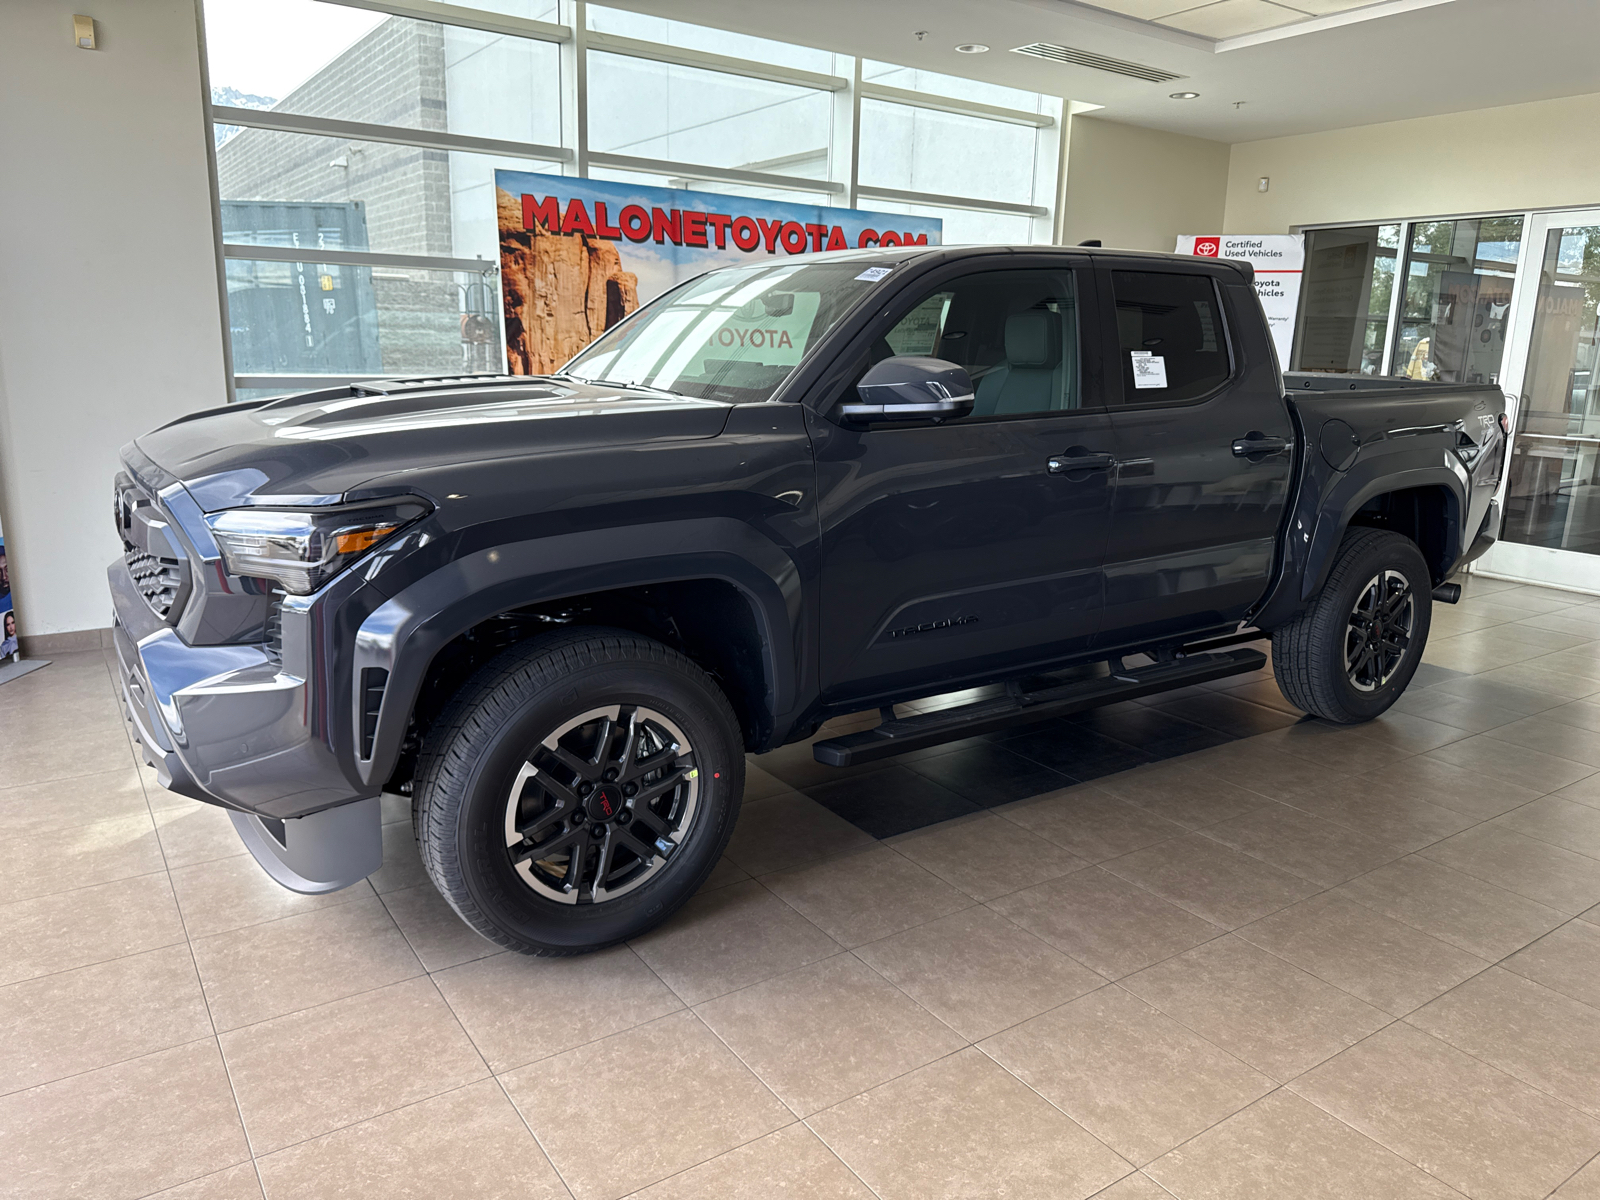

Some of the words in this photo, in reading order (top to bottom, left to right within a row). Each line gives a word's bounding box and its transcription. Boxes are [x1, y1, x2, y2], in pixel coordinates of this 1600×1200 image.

[521, 193, 927, 255] MALONETOYOTACOM
[1226, 240, 1262, 248] Certified
[1254, 280, 1280, 288] oyota
[1258, 289, 1284, 297] hicles
[901, 317, 930, 326] OYOTA
[1477, 414, 1495, 428] TRD
[886, 614, 979, 638] TACOMA
[600, 791, 613, 816] TRD
